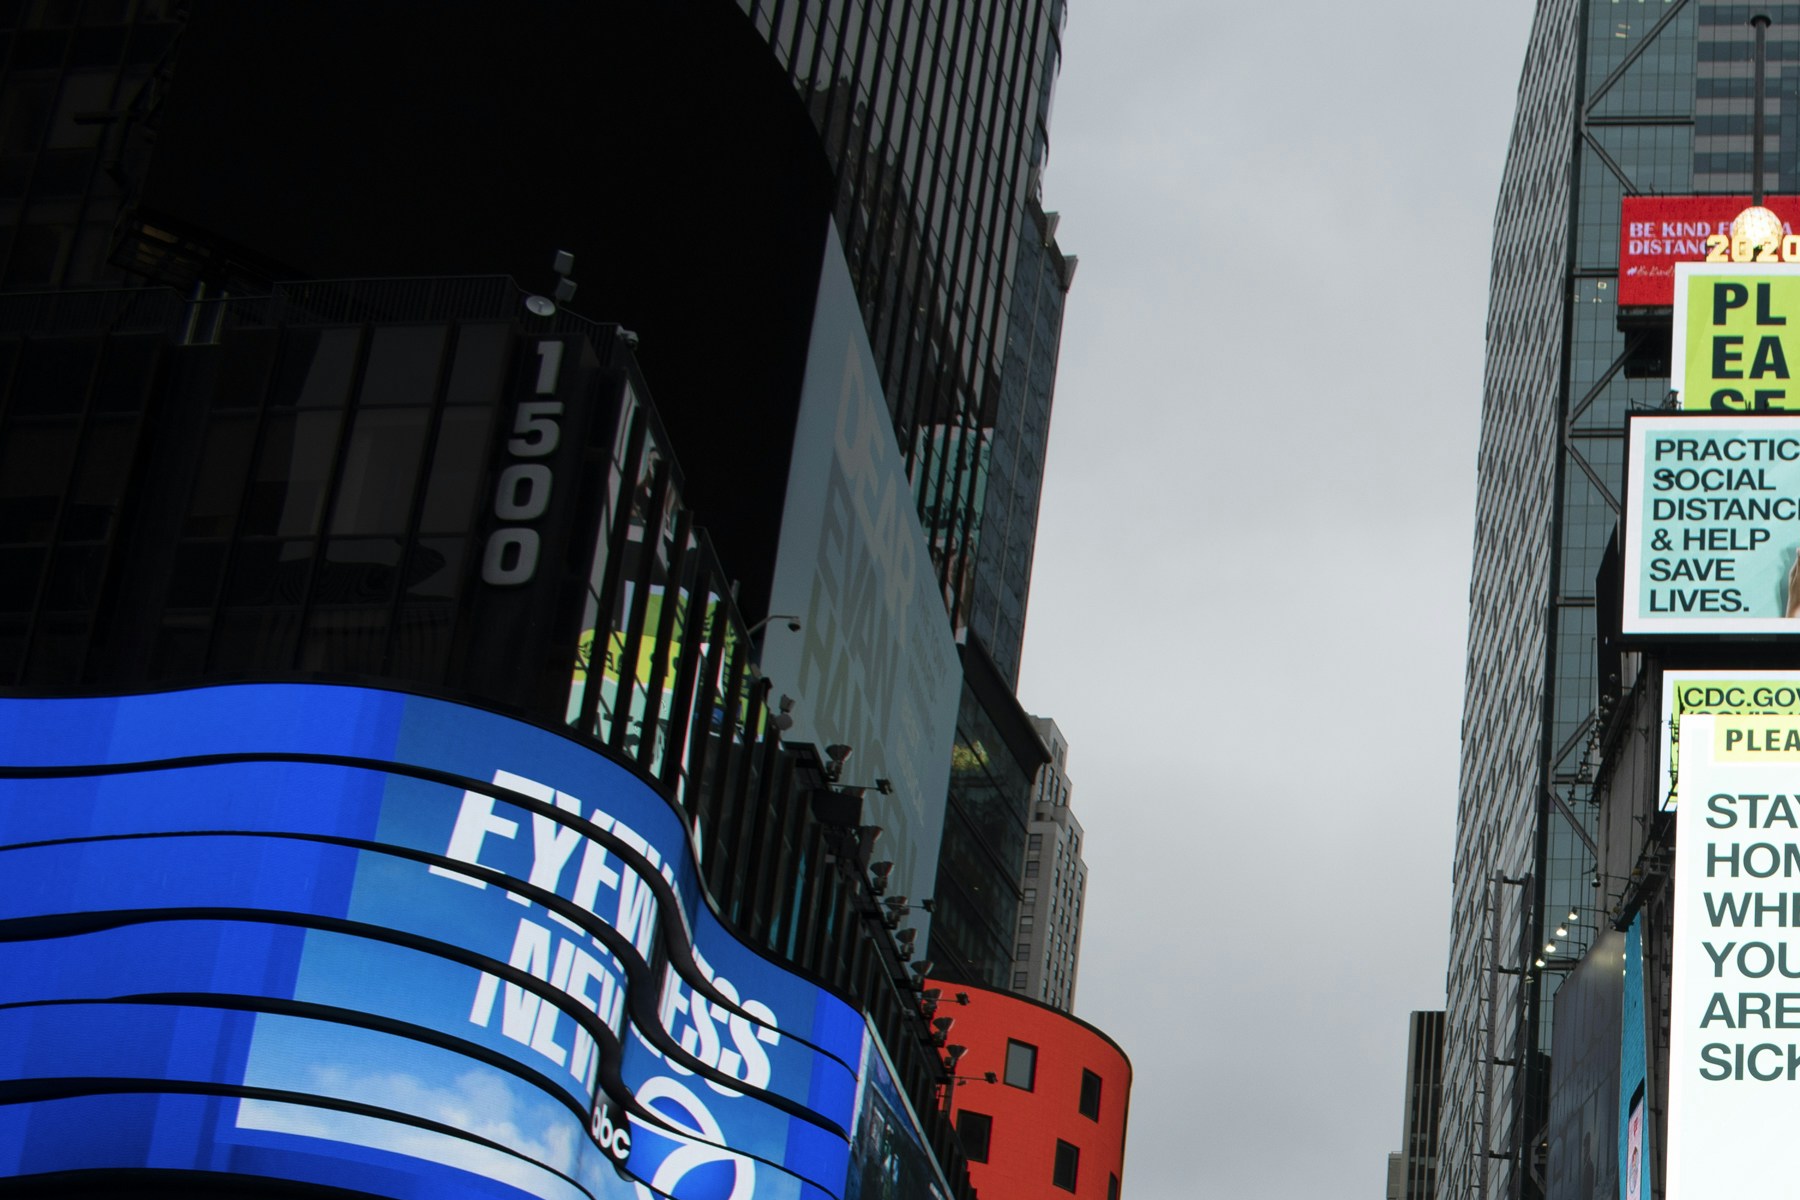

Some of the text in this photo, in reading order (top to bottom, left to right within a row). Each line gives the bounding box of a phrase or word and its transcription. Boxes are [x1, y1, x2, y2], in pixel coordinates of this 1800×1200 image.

[1630, 222, 1655, 237] BE
[1662, 222, 1710, 237] KIND
[1712, 283, 1787, 326] PL
[1711, 336, 1790, 380] EA
[482, 341, 565, 586] 1500
[1653, 468, 1777, 492] SOCIAL
[1650, 528, 1771, 552] & HELP
[1649, 558, 1735, 582] SAVE
[1649, 589, 1750, 613] LIVES.
[591, 1105, 631, 1160] abc
